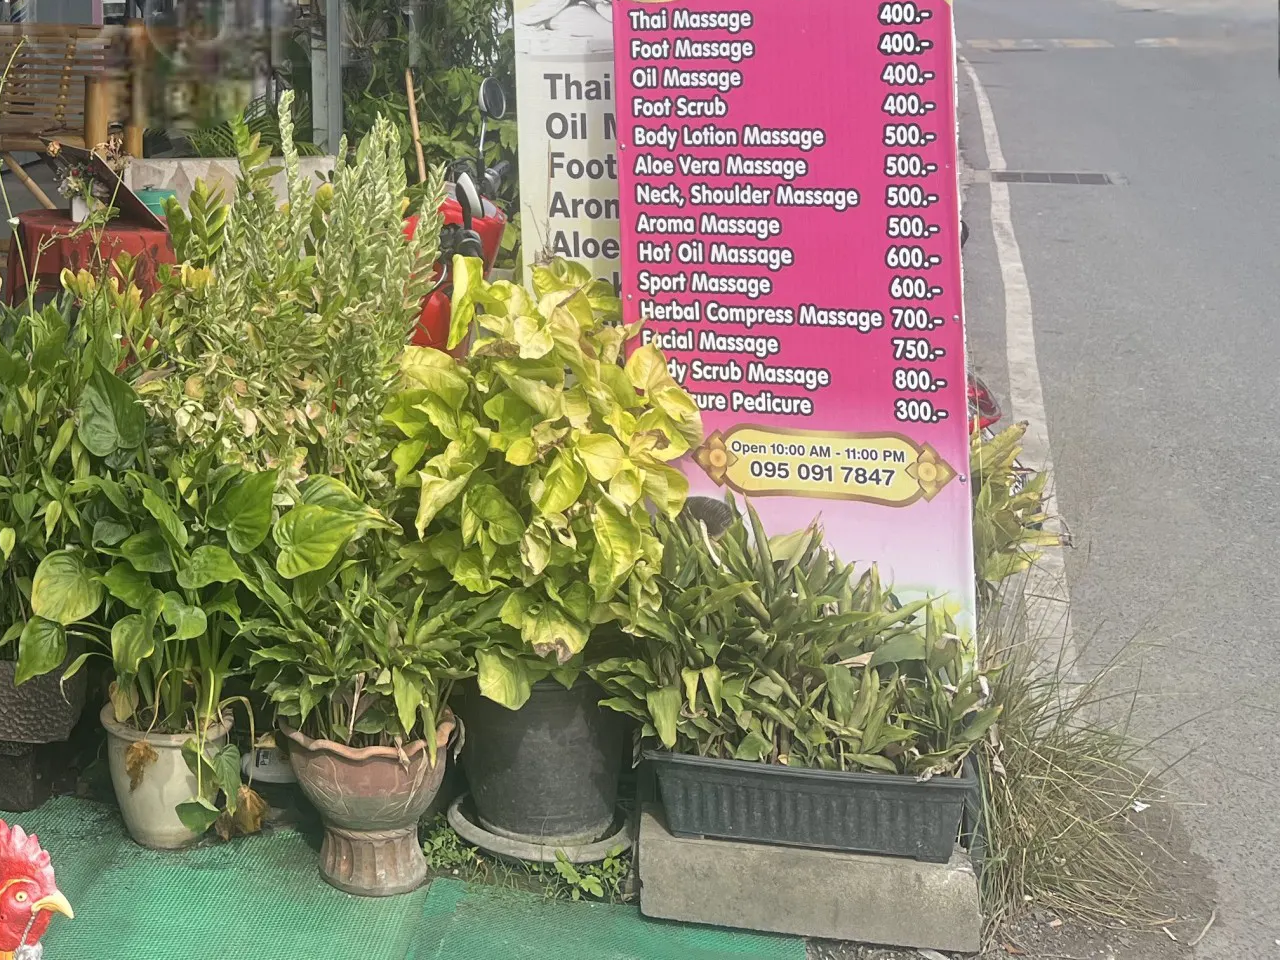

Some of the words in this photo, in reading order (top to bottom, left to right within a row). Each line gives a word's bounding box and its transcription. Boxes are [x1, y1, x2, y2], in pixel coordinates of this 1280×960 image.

[628, 8, 668, 30] Thai
[672, 9, 752, 33] Massage
[879, 2, 931, 24] 400.-
[631, 39, 671, 59] Foot
[674, 38, 754, 63] Massage
[879, 32, 931, 54] 400.-
[543, 73, 611, 101] Thai
[631, 67, 658, 88] Oil
[662, 67, 742, 92] Massage
[881, 63, 934, 85] 400.-
[632, 97, 673, 117] Foot
[675, 96, 727, 117] Scrub
[882, 93, 935, 115] 400.-
[545, 112, 587, 140] Oil
[633, 125, 679, 151] Body
[682, 124, 738, 146] Lotion
[742, 125, 825, 151] Massage
[884, 124, 936, 146] 500.-
[549, 151, 618, 180] Foot
[634, 154, 675, 175] Aloe
[678, 155, 721, 175] Vera
[725, 155, 807, 181] Massage
[885, 154, 937, 177] 500.-
[636, 183, 686, 208] Neck,
[690, 183, 772, 205] Shoulder
[775, 185, 859, 211] Massage
[886, 185, 938, 207] 500.-
[636, 213, 696, 234] Aroma
[700, 213, 781, 240] Massage
[887, 216, 939, 238] 500.-
[553, 230, 620, 259] Aloe
[638, 242, 672, 263] Hot
[677, 241, 704, 263] Oil
[709, 243, 793, 271] Massage
[886, 246, 941, 269] 600.-
[638, 270, 687, 296] Sport
[690, 272, 772, 299] Massage
[890, 276, 942, 299] 600.-
[640, 300, 701, 322] Herbal
[705, 302, 795, 328] Compress
[798, 304, 883, 333] Massage
[891, 307, 944, 330] 700.-
[698, 330, 780, 359] Massage
[892, 338, 945, 361] 750.-
[665, 359, 688, 384] dy
[691, 359, 743, 382] Scrub
[747, 362, 830, 391] Massage
[894, 368, 946, 392] 800.-
[731, 391, 813, 415] Pedicure
[895, 399, 948, 422] 300.-
[731, 440, 767, 455] Open
[770, 443, 806, 457] 10:00
[809, 445, 832, 458] AM
[844, 447, 879, 461] 11:00
[882, 449, 906, 463] PM
[750, 460, 791, 479] 095
[797, 463, 834, 482] 091
[840, 466, 896, 486] 7847
